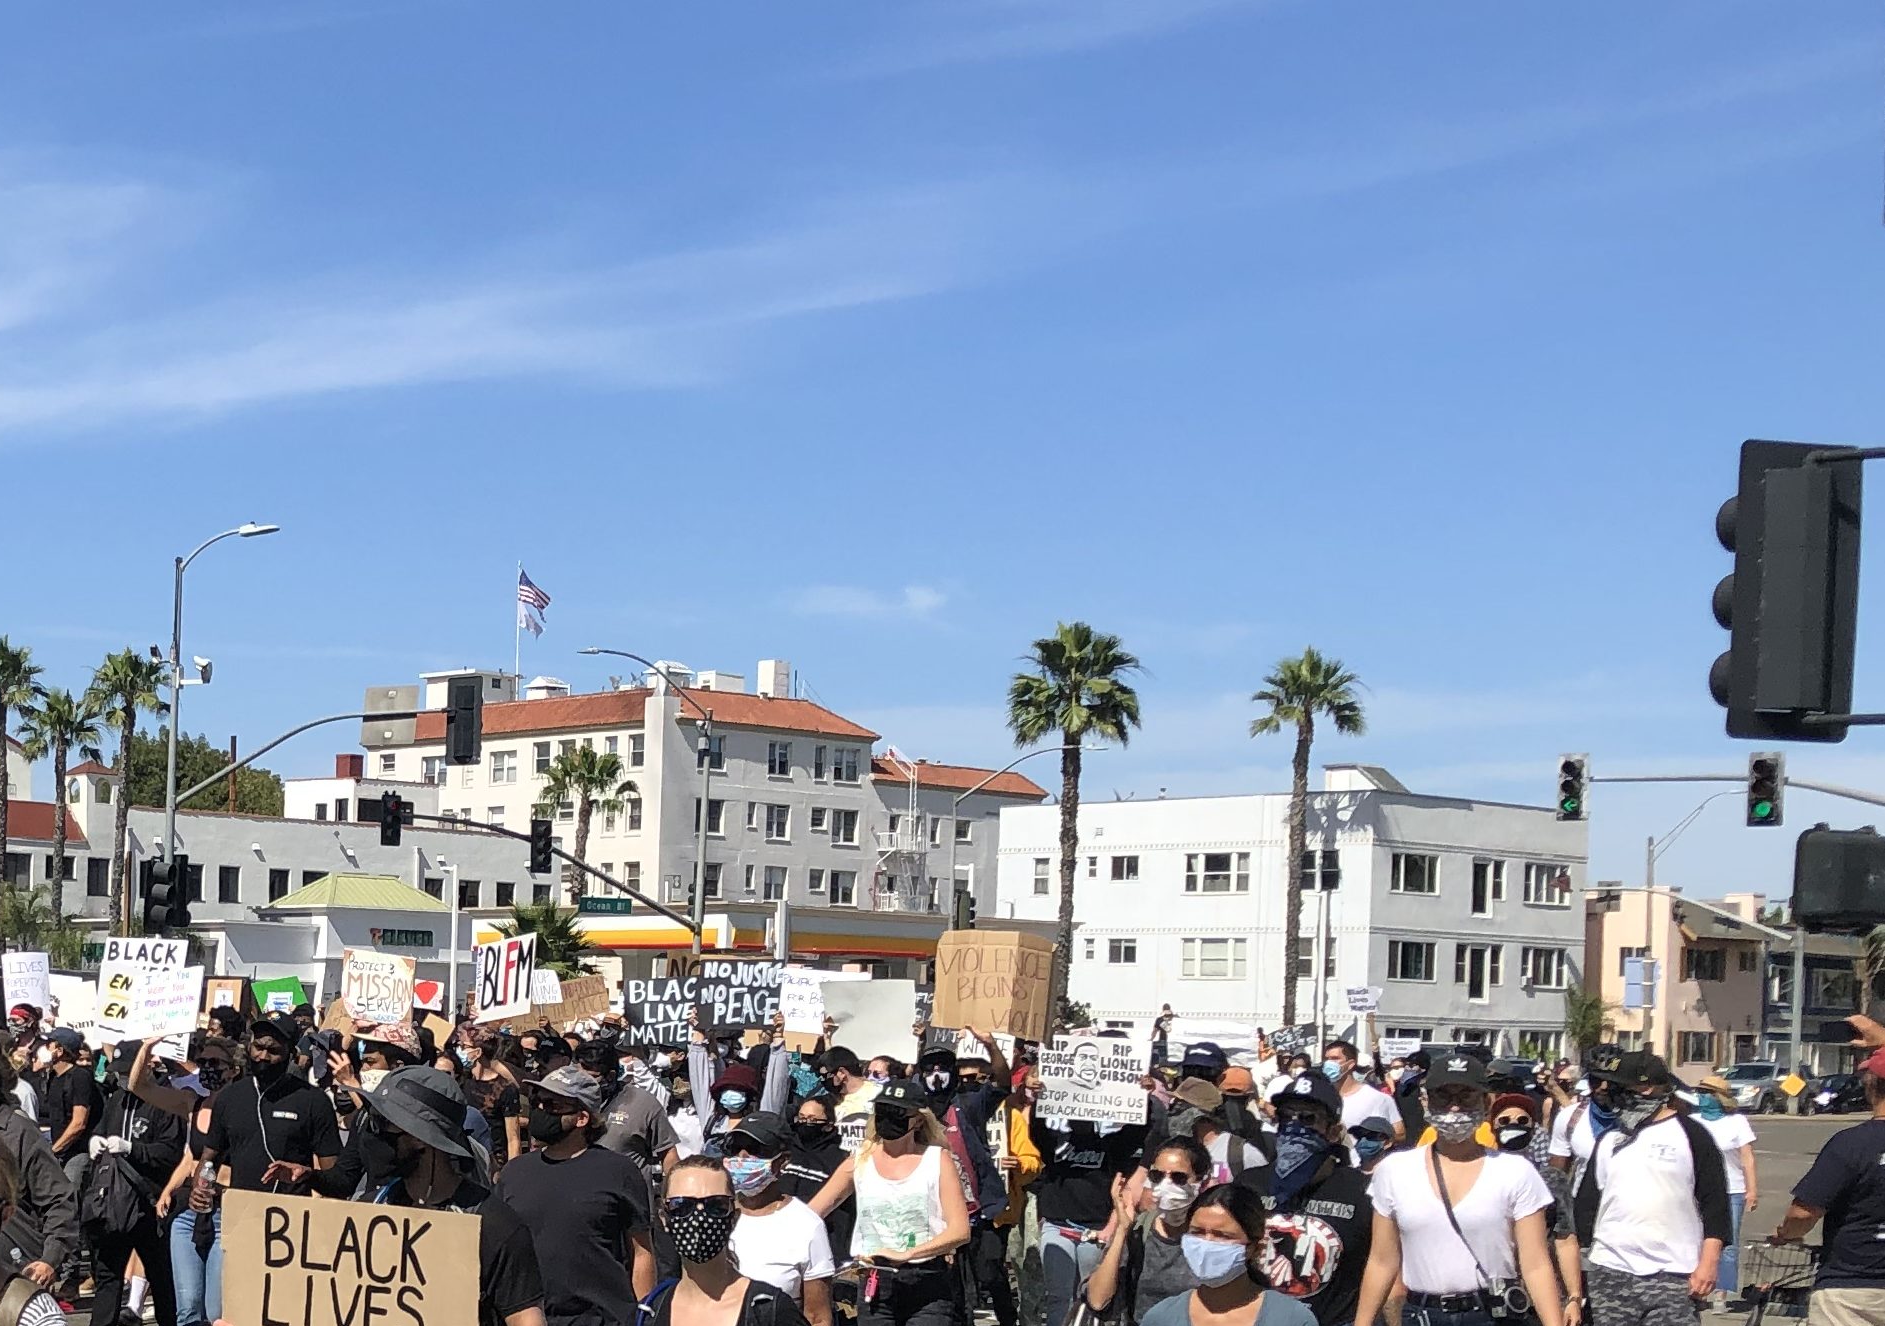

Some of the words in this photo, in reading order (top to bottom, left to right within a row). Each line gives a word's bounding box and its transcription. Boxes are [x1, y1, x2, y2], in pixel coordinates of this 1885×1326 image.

[107, 941, 178, 965] BLACK
[348, 951, 386, 972] PROTECT
[938, 947, 1048, 980] VIOLENCE
[9, 960, 43, 974] LIVES
[704, 961, 729, 980] NO
[731, 960, 784, 988] JUSTICE
[347, 972, 414, 1003] MISSION
[629, 976, 696, 1003] BLAC
[957, 975, 1028, 1002] BEGINS
[644, 1001, 695, 1024] LIVE
[700, 983, 727, 1005] NO
[714, 986, 777, 1026] PEACE
[630, 1020, 696, 1046] MATTE
[1055, 1040, 1069, 1052] IP
[1112, 1044, 1133, 1057] RIP
[1040, 1052, 1075, 1066] GEORGE
[1100, 1057, 1143, 1072] LIONEL
[1041, 1065, 1075, 1078] FLOYD
[1040, 1089, 1068, 1101] STOP
[1072, 1092, 1122, 1108] KILLING
[1127, 1098, 1144, 1109] US
[1036, 1104, 1144, 1122] #BLACKLIVESMATTER
[265, 1206, 432, 1286] BLACK
